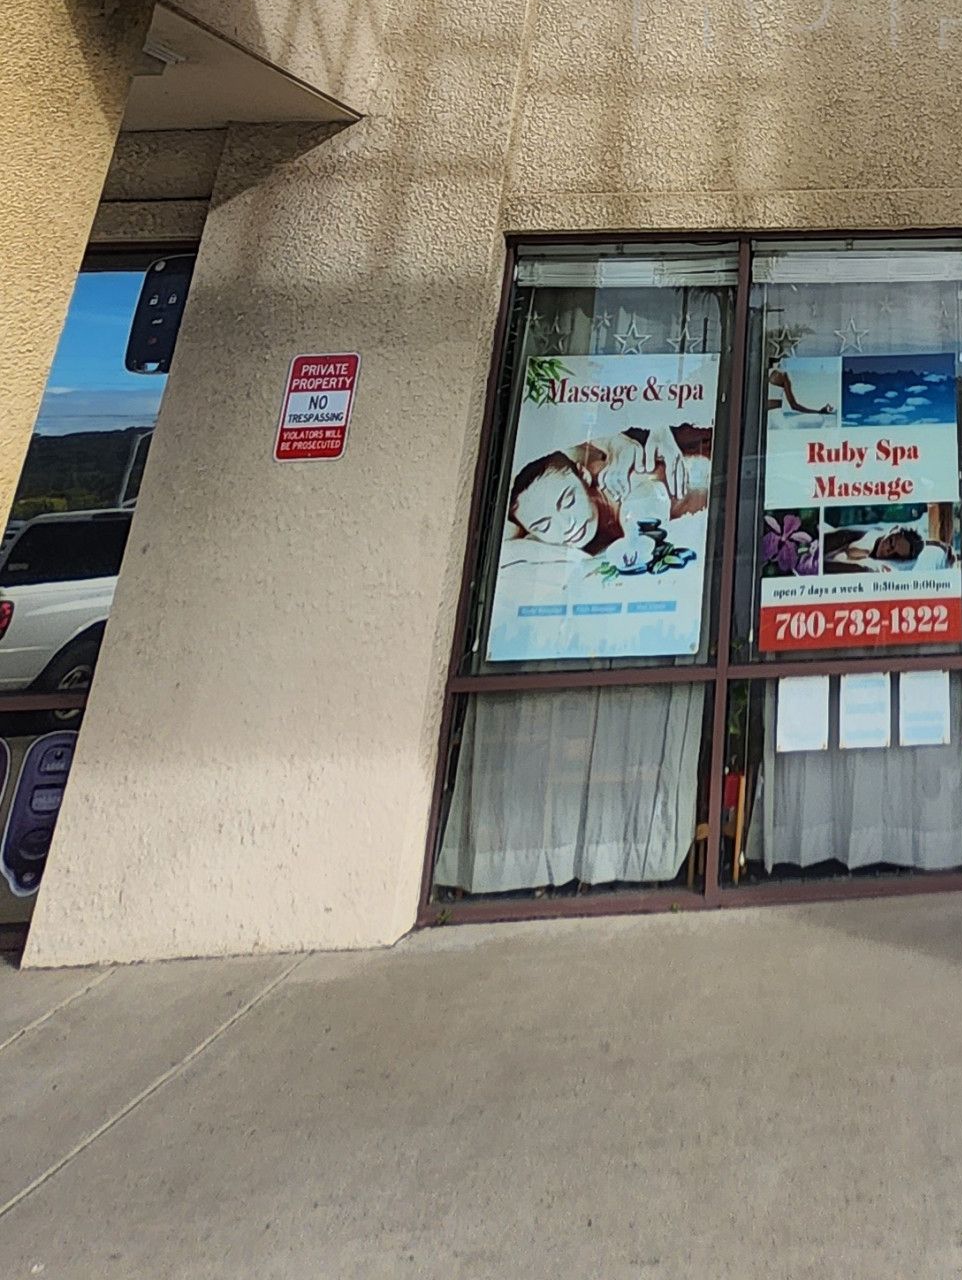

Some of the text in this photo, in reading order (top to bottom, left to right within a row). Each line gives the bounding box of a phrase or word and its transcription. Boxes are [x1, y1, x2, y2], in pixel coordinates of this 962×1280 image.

[301, 363, 350, 376] PRIVATE
[291, 376, 353, 390] PROPERTY
[546, 376, 704, 411] Massage & spa
[308, 395, 328, 411] NO
[287, 412, 344, 423] TRESPASSING
[283, 429, 342, 440] VIOLATORS WILL
[280, 440, 341, 451] BE PROSECUTED
[807, 439, 919, 468] Ruby Spa
[812, 475, 914, 501] Massage
[773, 588, 797, 599] open
[799, 586, 806, 596] 7
[807, 585, 829, 598] days
[831, 587, 837, 595] a
[840, 583, 864, 594] week
[775, 604, 949, 640] 760-732-1322
